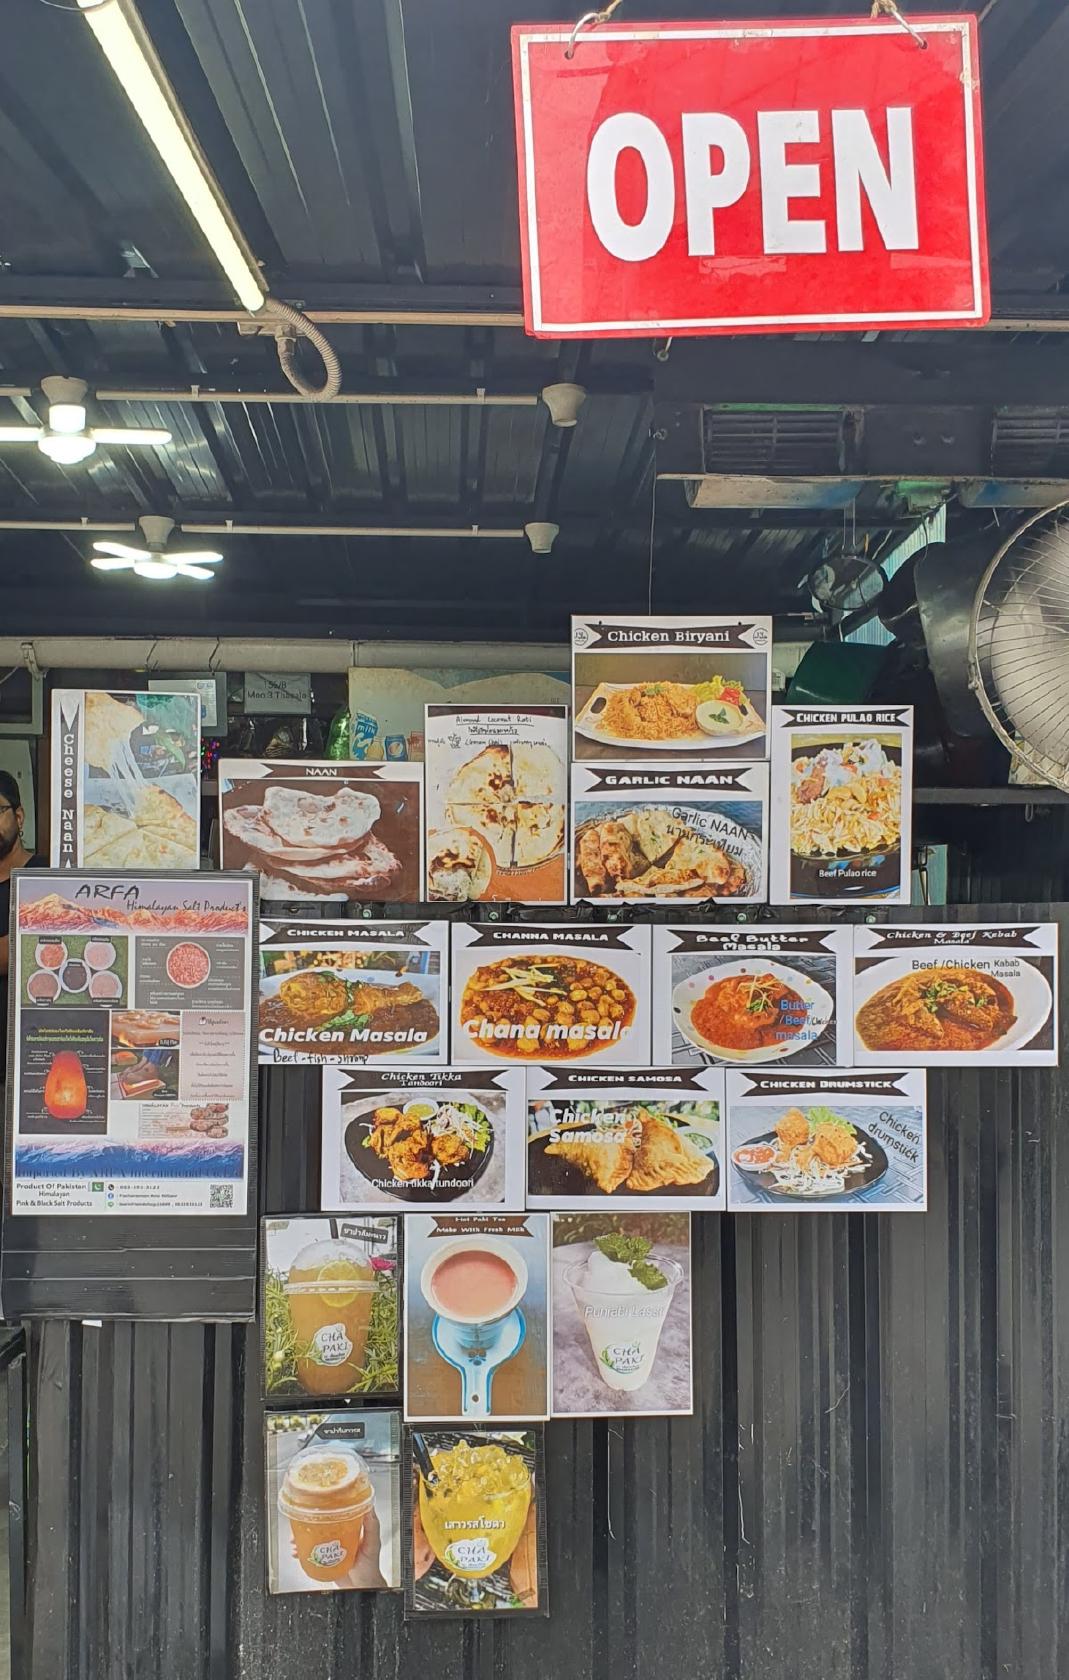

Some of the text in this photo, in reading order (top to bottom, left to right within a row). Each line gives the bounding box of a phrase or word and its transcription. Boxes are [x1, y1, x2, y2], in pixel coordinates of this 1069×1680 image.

[587, 106, 919, 262] OPEN
[607, 630, 730, 643] Chicken Biryani
[796, 713, 896, 723] CHICKEN PULAO RICE
[305, 767, 338, 776] NAAN
[605, 775, 733, 785] GARLIC NAAN
[62, 733, 75, 853] Cheese Naan
[672, 807, 749, 841] Garlic NAAN
[818, 868, 877, 878] Beef Pulao rice
[75, 883, 140, 900] ARFA
[126, 899, 247, 915] Himalayan Salt Product's
[287, 929, 344, 937] CHICKEN
[493, 932, 609, 941] CHANNA MASALA
[695, 933, 809, 943] Beef Butter
[886, 931, 932, 939] Chicken
[952, 931, 977, 941] Beef
[981, 931, 1018, 939] Kebab
[722, 942, 781, 951] Masala
[911, 959, 938, 970] Beef
[993, 959, 1020, 967] Kabab
[990, 969, 1021, 977] Masala
[461, 1018, 541, 1040] Chana
[258, 1027, 428, 1043] Chicken Masala
[775, 1030, 818, 1041] masala
[273, 1047, 298, 1063] Beef
[381, 1072, 462, 1081] Chicken Tikka
[568, 1074, 625, 1082] CHICKEN
[760, 1080, 892, 1089] CHICKEN DRUMSTICK
[549, 1107, 626, 1124] Chicken
[878, 1110, 921, 1145] Chicken
[549, 1128, 625, 1143] Samosa
[867, 1121, 920, 1164] drumstick
[371, 1178, 409, 1188] Chicken
